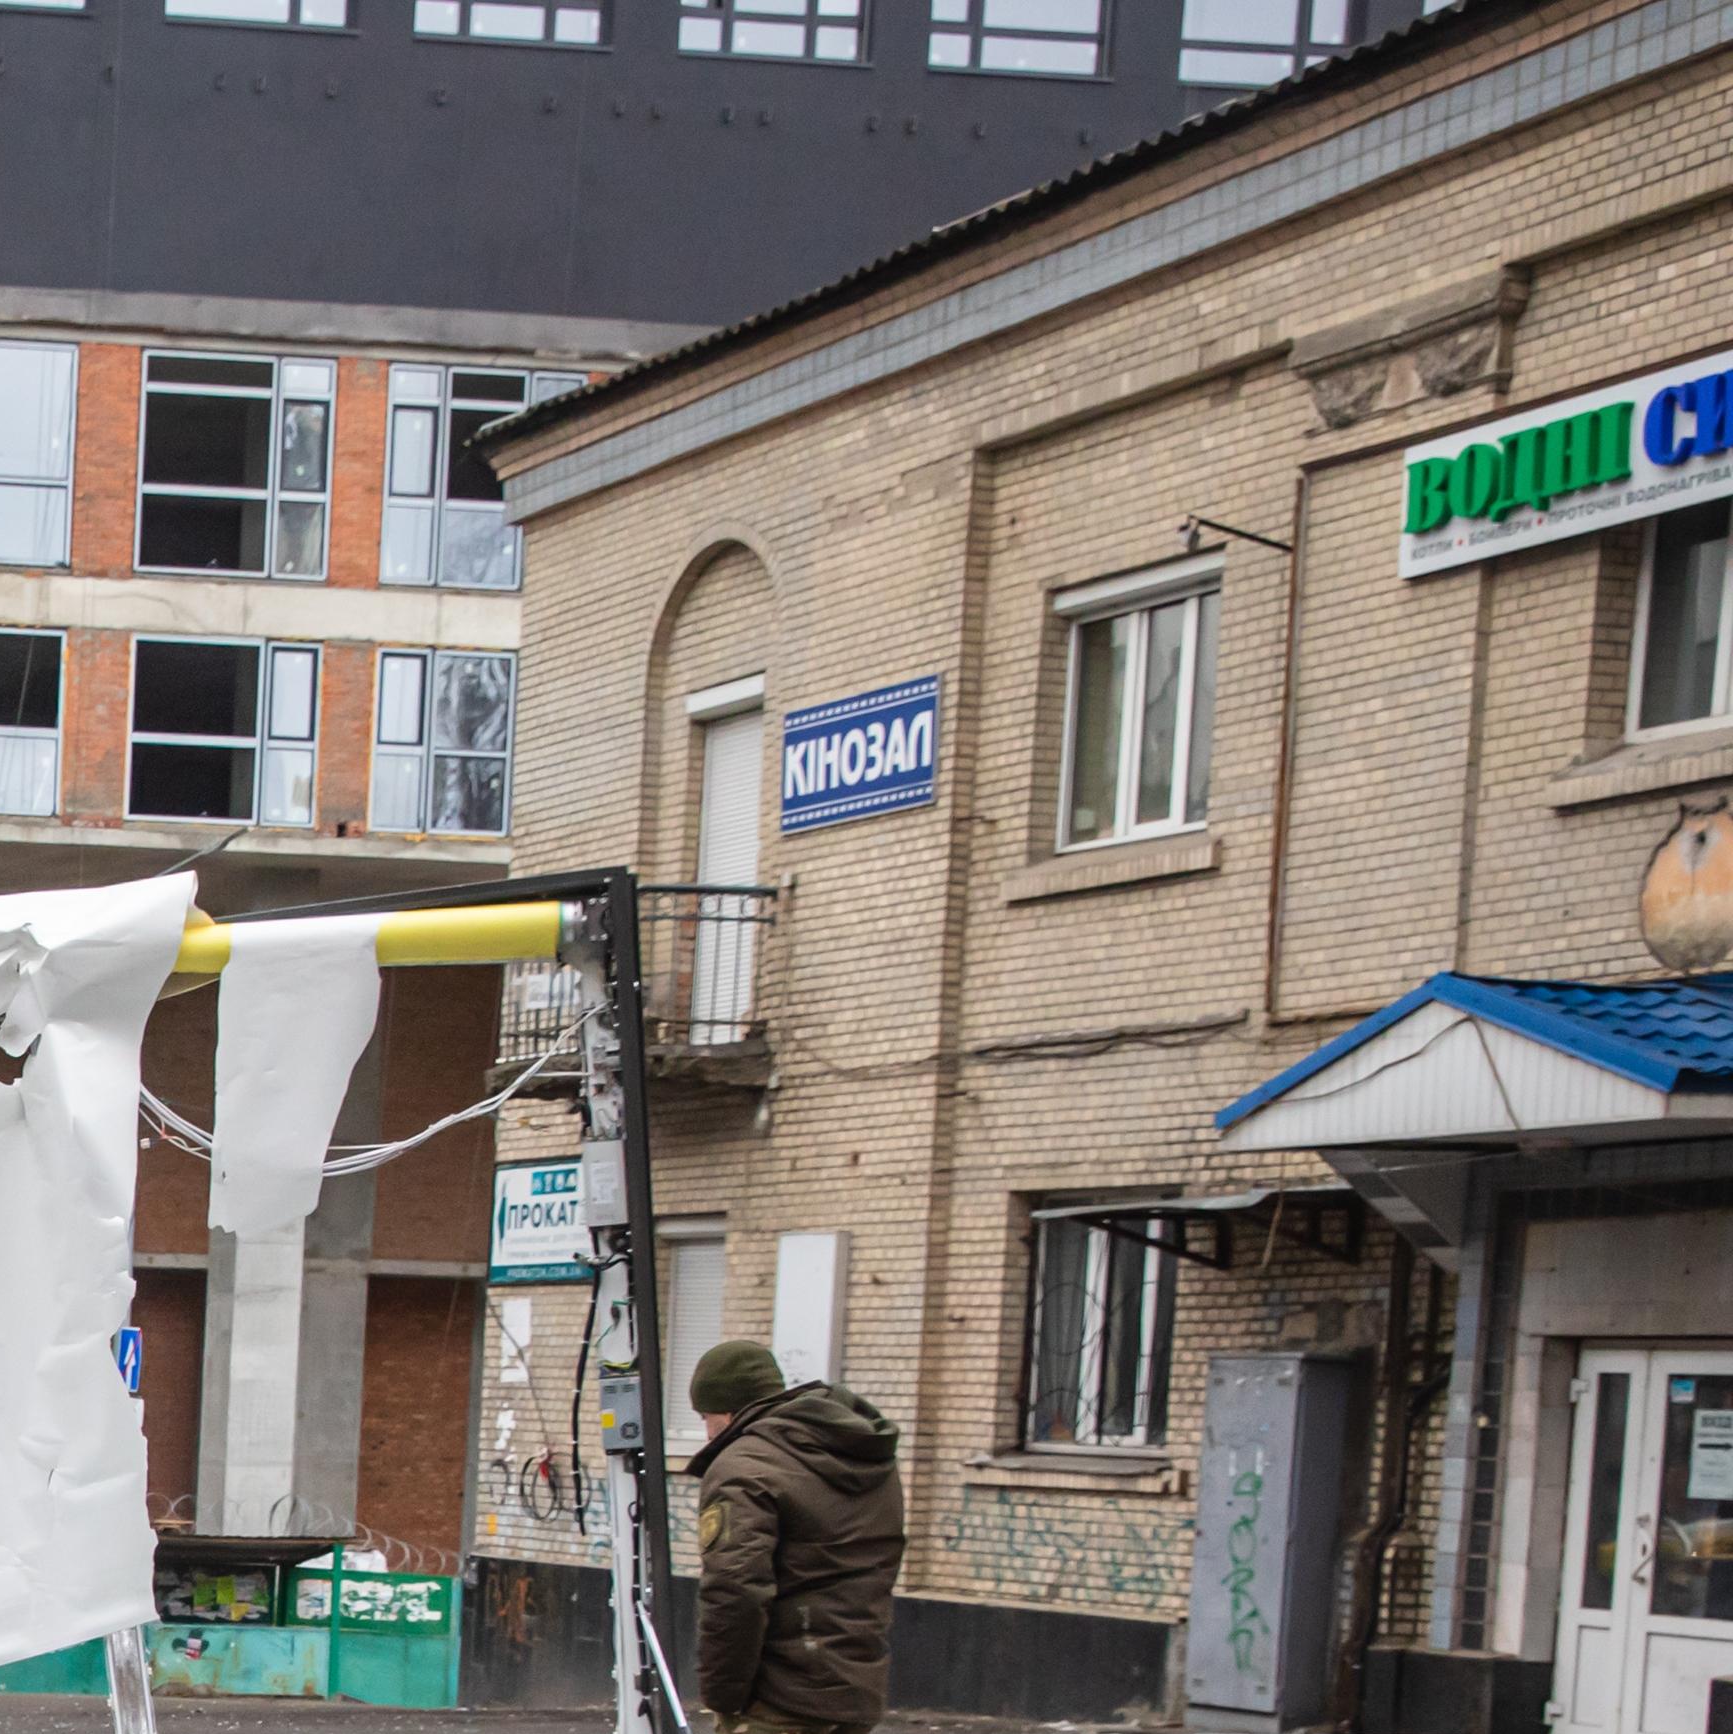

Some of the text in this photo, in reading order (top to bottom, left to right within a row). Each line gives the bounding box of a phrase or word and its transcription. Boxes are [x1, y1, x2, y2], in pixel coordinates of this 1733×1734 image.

[1404, 401, 1635, 534] ВОДНІ
[1547, 495, 1622, 525] ПРОТОЧНІ
[783, 709, 934, 799] КІНОЗАЛ
[506, 1200, 579, 1230] ПРОКАТ
